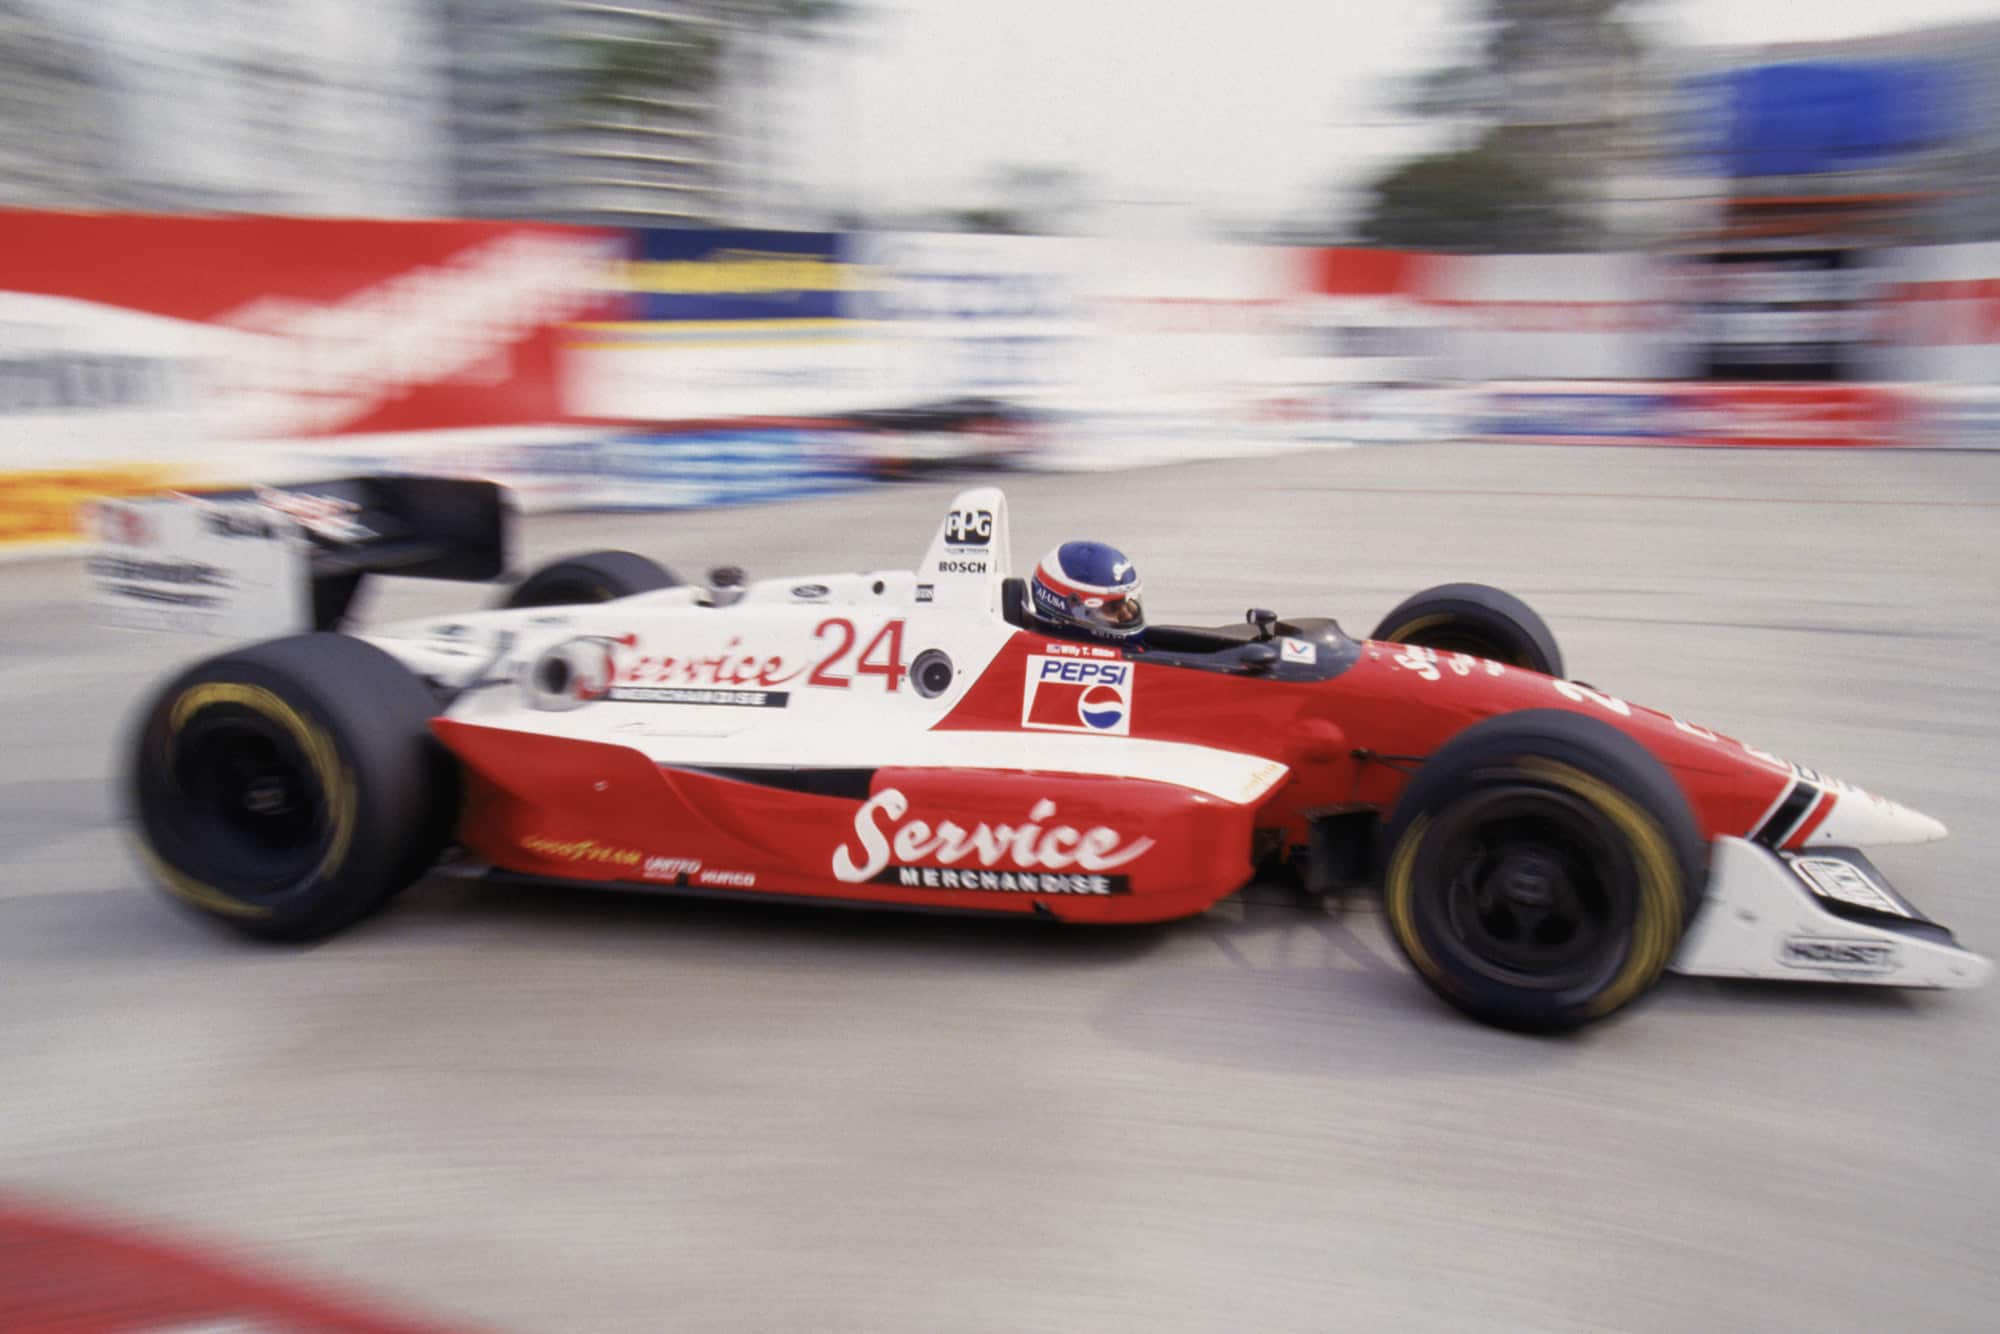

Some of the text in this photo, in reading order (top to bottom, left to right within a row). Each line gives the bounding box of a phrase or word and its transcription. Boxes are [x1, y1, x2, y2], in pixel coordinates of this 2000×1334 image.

[946, 510, 992, 541] PPG
[938, 561, 987, 573] BOSCH
[808, 617, 907, 692] 24
[1040, 660, 1127, 685] PEPSI
[831, 787, 1156, 884] Service
[899, 867, 1111, 895] MERCHANDISE
